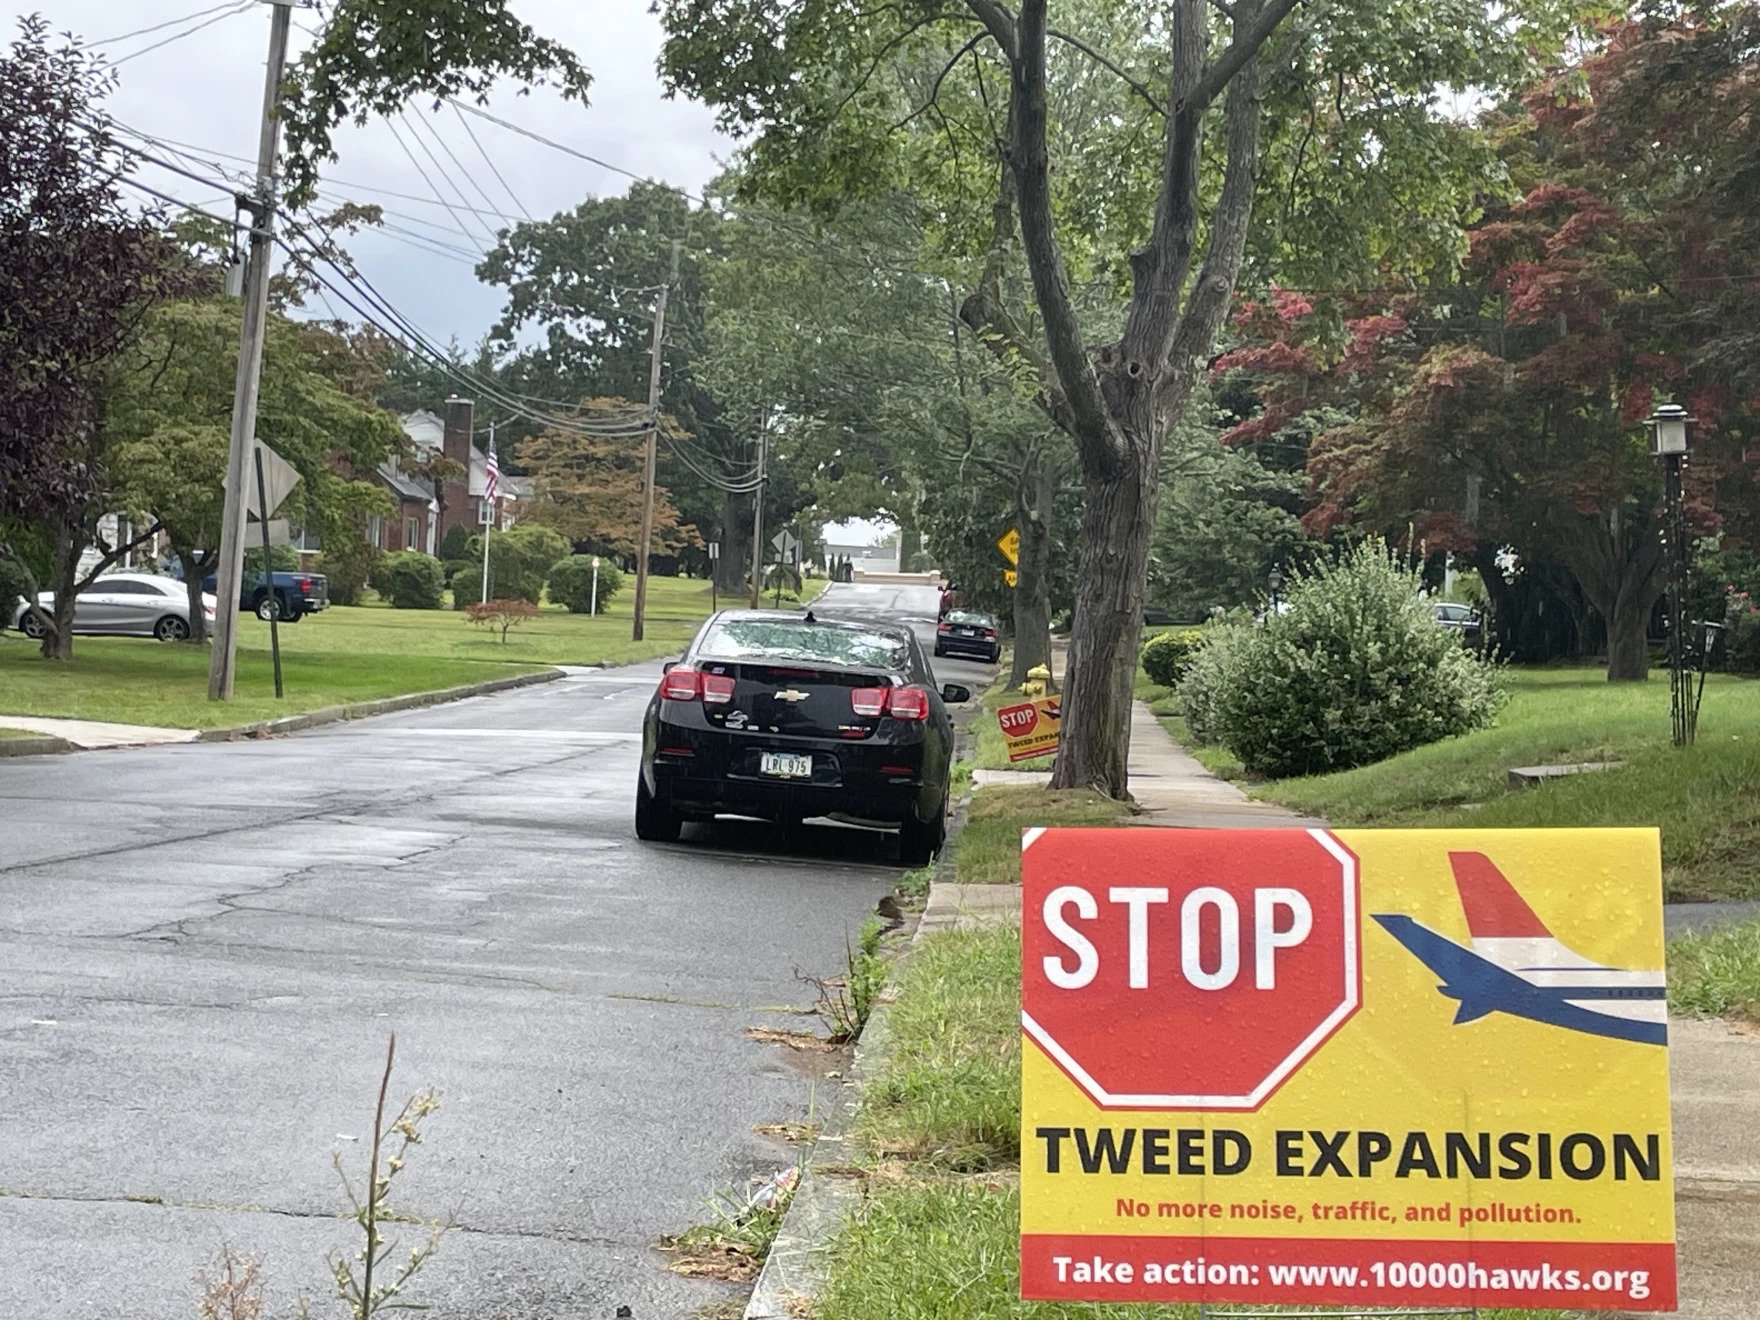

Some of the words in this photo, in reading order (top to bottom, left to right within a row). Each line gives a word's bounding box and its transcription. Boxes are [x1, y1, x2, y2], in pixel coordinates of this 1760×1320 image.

[1001, 709, 1034, 728] STOP
[789, 759, 806, 773] 975
[1042, 886, 1313, 991] STOP
[1036, 1127, 1252, 1175] TWEED
[1275, 1130, 1660, 1181] EXPANSION
[1116, 1198, 1150, 1218] No
[1158, 1200, 1222, 1219] more
[1229, 1199, 1304, 1223] noise,
[1311, 1200, 1397, 1224] traffic,
[1405, 1202, 1451, 1222] and
[1459, 1202, 1582, 1227] pollution.
[1053, 1257, 1134, 1284] Take
[1143, 1258, 1260, 1286] action:
[1268, 1262, 1651, 1299] www.10000hawks.org
